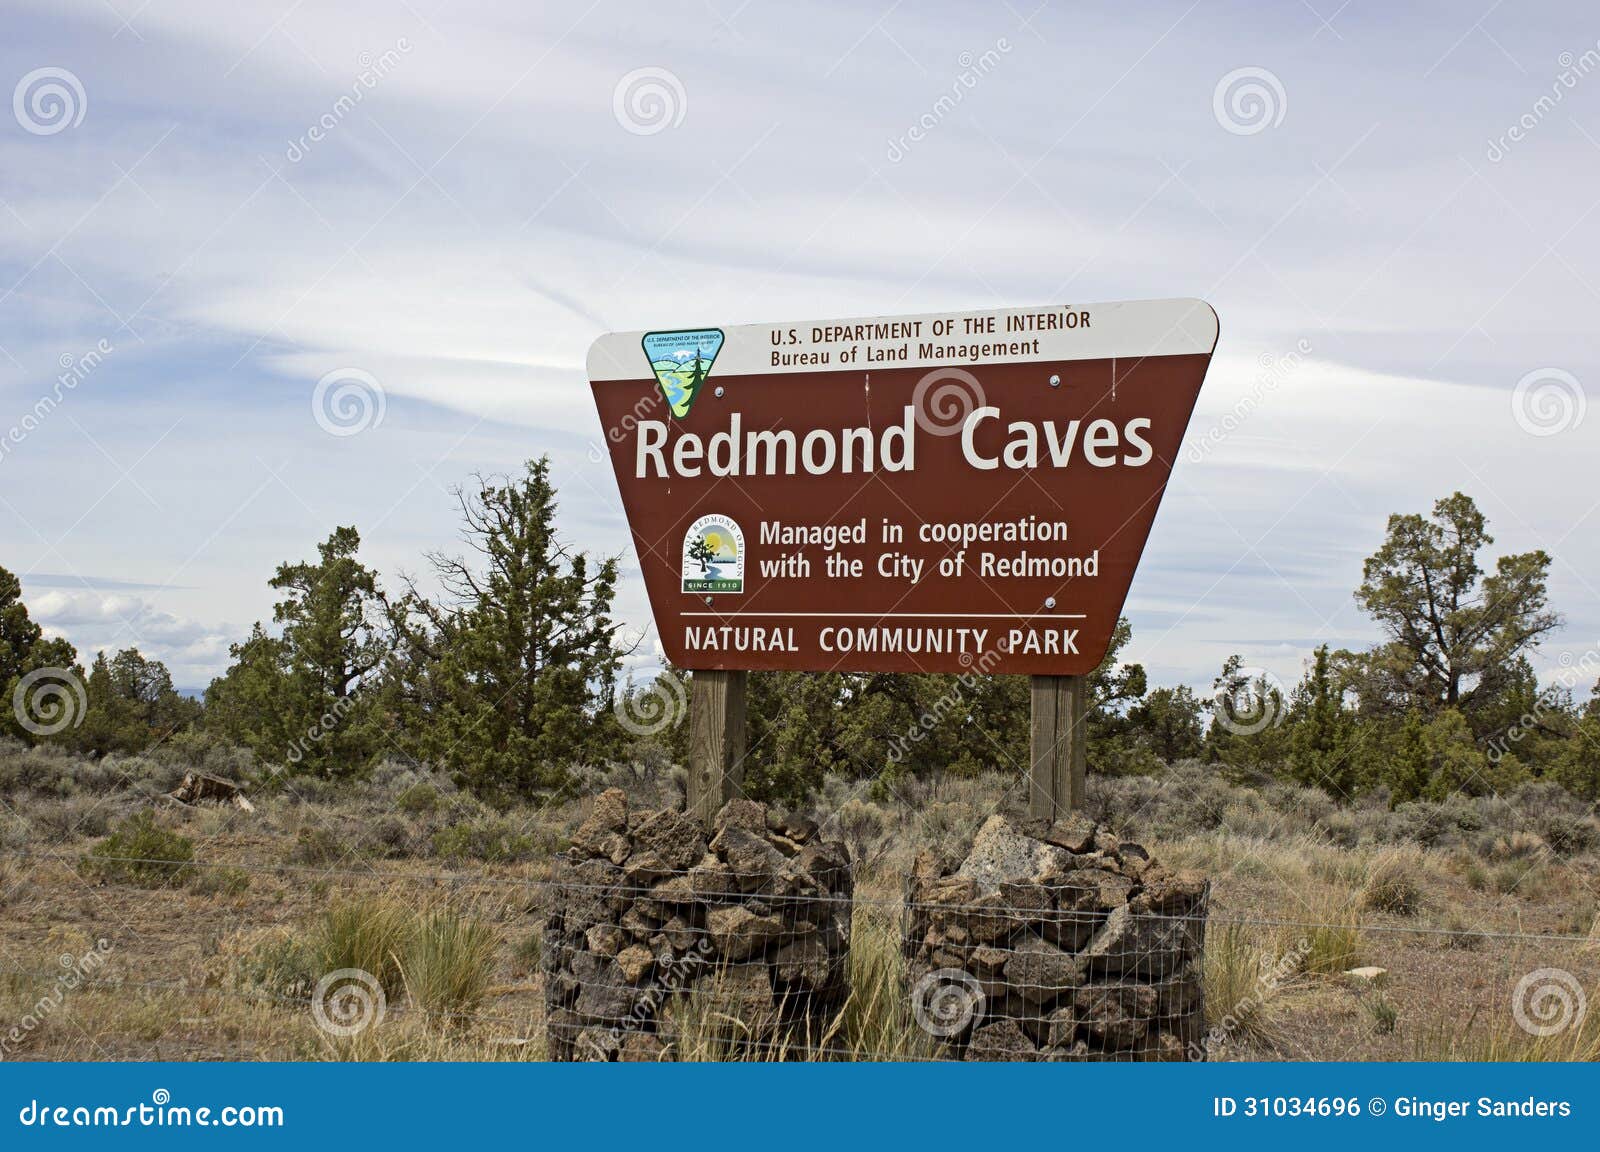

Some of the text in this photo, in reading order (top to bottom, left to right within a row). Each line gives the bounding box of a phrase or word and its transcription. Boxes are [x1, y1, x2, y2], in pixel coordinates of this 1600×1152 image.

[771, 311, 1092, 346] U.S. DEPARTMENT OF THE INTERIOR
[770, 338, 1041, 367] Bureau of Land Management
[635, 404, 1154, 479] Redmond Caves
[760, 515, 1069, 551] Managed in cooperation
[759, 549, 1100, 584] with the City of Redmond
[684, 626, 1081, 655] NATURAL COMMUNITY PARK
